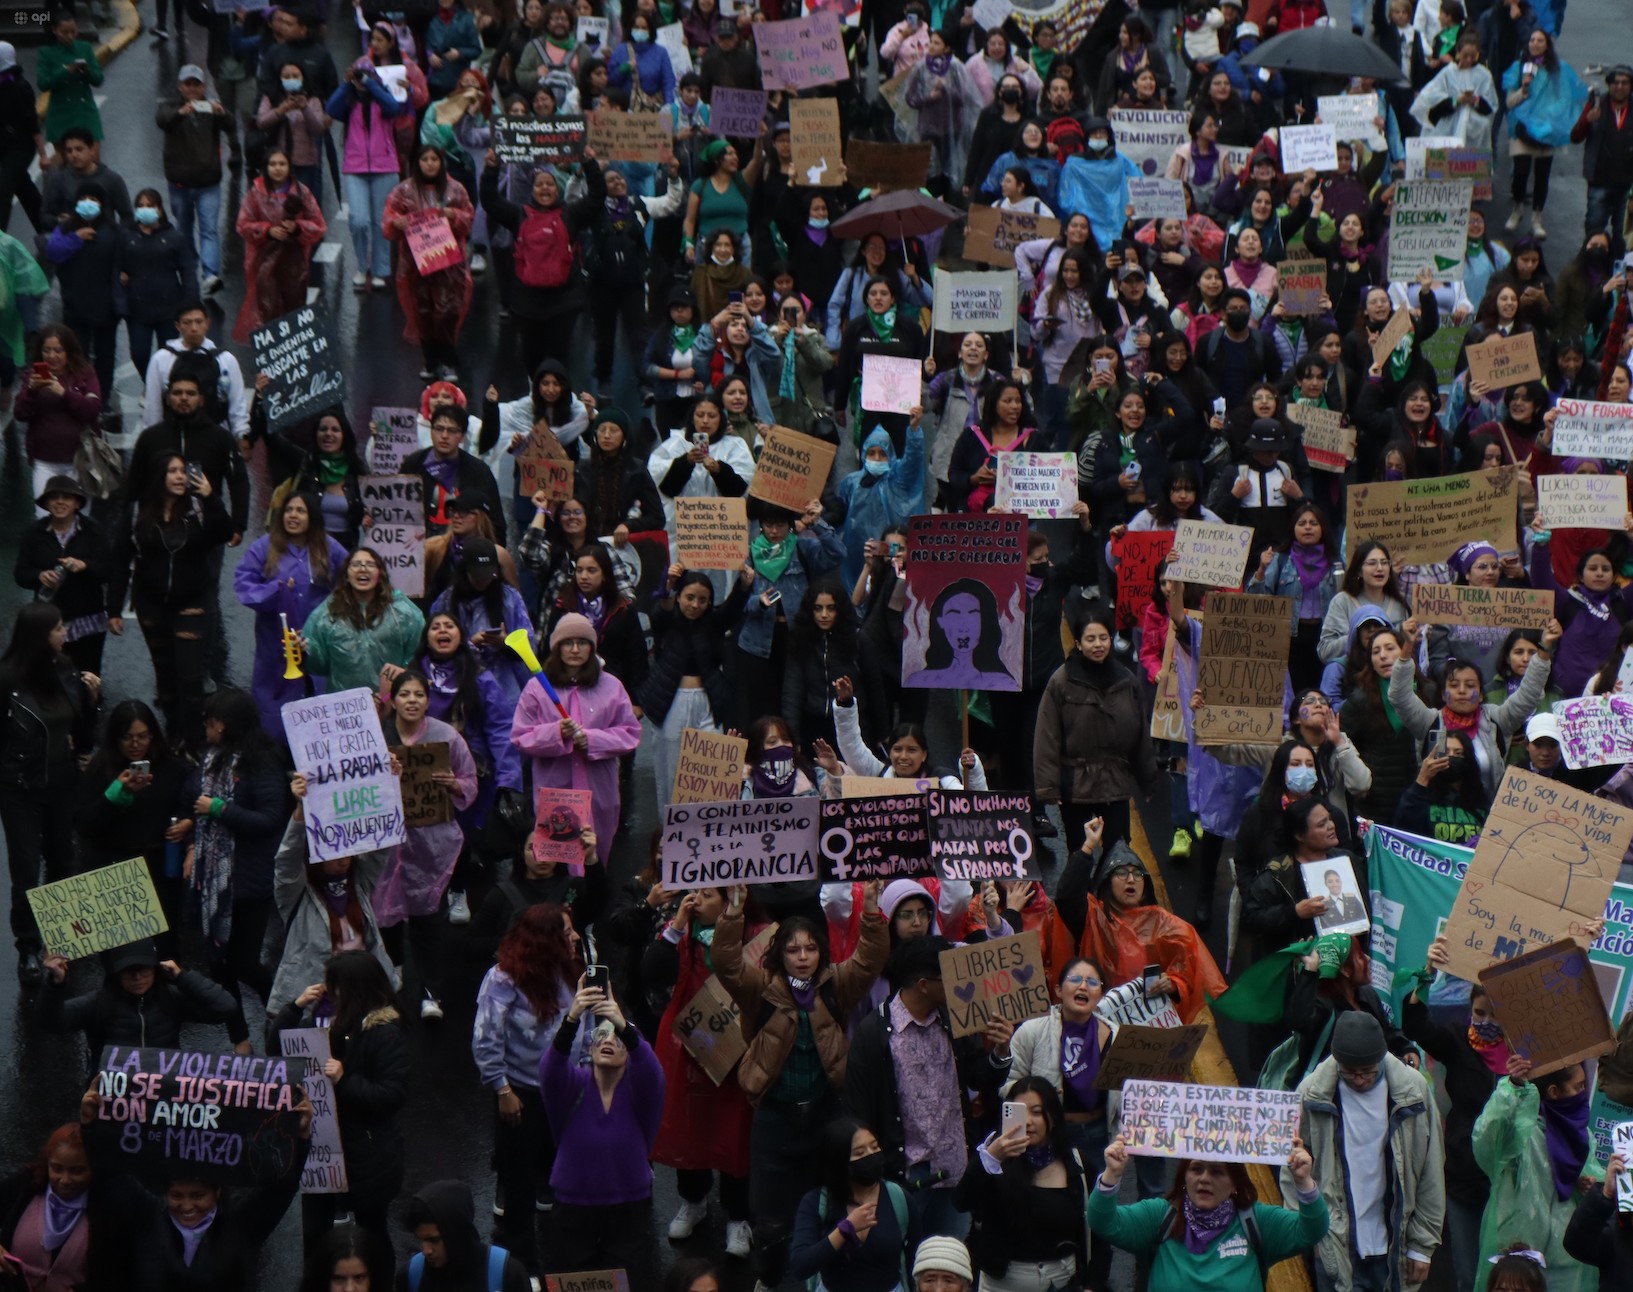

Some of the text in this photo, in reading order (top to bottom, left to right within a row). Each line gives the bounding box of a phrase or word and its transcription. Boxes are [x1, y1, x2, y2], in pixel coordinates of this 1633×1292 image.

[720, 118, 758, 133] FUEGO
[1114, 132, 1186, 145] FEMINISTA
[1396, 207, 1448, 226] DECISIÓN
[1286, 276, 1323, 290] RABIA
[951, 301, 960, 310] LA
[975, 302, 989, 310] QUE
[988, 299, 1003, 310] NO
[1488, 363, 1530, 380] FEMINISM
[1493, 356, 1510, 368] AND
[286, 363, 308, 384] LAS
[374, 443, 393, 452] RON
[374, 453, 398, 462] PERO
[760, 451, 811, 476] MARCHANDO
[522, 464, 568, 489] NO ES NO
[1011, 468, 1061, 477] TODAS LAS MADRES
[364, 483, 423, 500] ANTES
[1014, 482, 1056, 491] MERECEN VER A
[676, 501, 726, 512] Mientras 6
[1012, 498, 1060, 508] SUS HIJAS VOLVER
[1541, 503, 1608, 516] NO TENGA QUE
[371, 508, 416, 522] PUTA
[680, 511, 728, 522] de cada 10
[1353, 520, 1379, 530] Vamos
[1382, 516, 1402, 527] hacer
[1436, 512, 1460, 522] Vamos
[1462, 510, 1466, 518] a
[913, 520, 1021, 532] EN MEMORIA DE
[1182, 526, 1234, 542] EN MEMORIA
[371, 528, 406, 544] QUE
[918, 535, 1018, 548] TODAS A LAS QUE
[911, 550, 1022, 565] NO LES CREYERON
[1176, 542, 1238, 557] DE TODAS LAS
[1124, 566, 1136, 582] DE
[1212, 598, 1286, 616] NO DOY VIDA A
[1416, 599, 1551, 616] MUJERES SOMOS TERRITORIO
[292, 693, 368, 726] DONDE EXISTIÓ
[1164, 700, 1178, 710] NO
[320, 714, 362, 735] EL MIEDO
[304, 739, 331, 762] HOY
[338, 730, 378, 756] GRITA
[683, 730, 738, 762] MARCHO
[317, 764, 338, 784] LA
[340, 752, 383, 782] RABIA
[680, 756, 718, 778] PORQUE
[678, 774, 740, 800] ESTOY VIVA
[332, 785, 382, 815] LIBRE
[930, 791, 1032, 817] SI NO LUCHAMOS
[1502, 792, 1540, 814] de tu
[667, 802, 793, 826] LO CONTRARIO
[668, 818, 811, 842] AL FEMINISMO
[856, 828, 928, 844] ANTES QUE
[937, 817, 1020, 839] JUNTAS NOS
[711, 842, 744, 852] ES LA
[856, 846, 884, 861] LAS
[930, 839, 1009, 858] MATAN POR
[1379, 828, 1452, 876] Verdad
[670, 850, 814, 884] IGNORANCIA
[942, 858, 1012, 880] SEPARADO
[36, 882, 147, 930] PARA LAS MUJERES
[44, 898, 156, 947] QUE NO HAYA PAZ
[952, 942, 1024, 981] LIBRES
[982, 970, 1012, 998] NO
[284, 1036, 310, 1056] UNA
[106, 1046, 288, 1084] LA VIOLENCIA
[98, 1070, 294, 1112] NO SE JUSTIFICA
[312, 1079, 326, 1098] YO
[1124, 1083, 1302, 1105] AHORA ESTAR DE SUERTE
[97, 1096, 222, 1130] CON AMOR
[1124, 1098, 1298, 1124] ES QUE A LA MUERTE NO LE
[1122, 1112, 1294, 1139] GUSTE TU CINTURA Y QUE
[119, 1121, 244, 1166] 8 DE MARZO
[1219, 1246, 1248, 1259] Beauty
[582, 1278, 613, 1292] niñas
